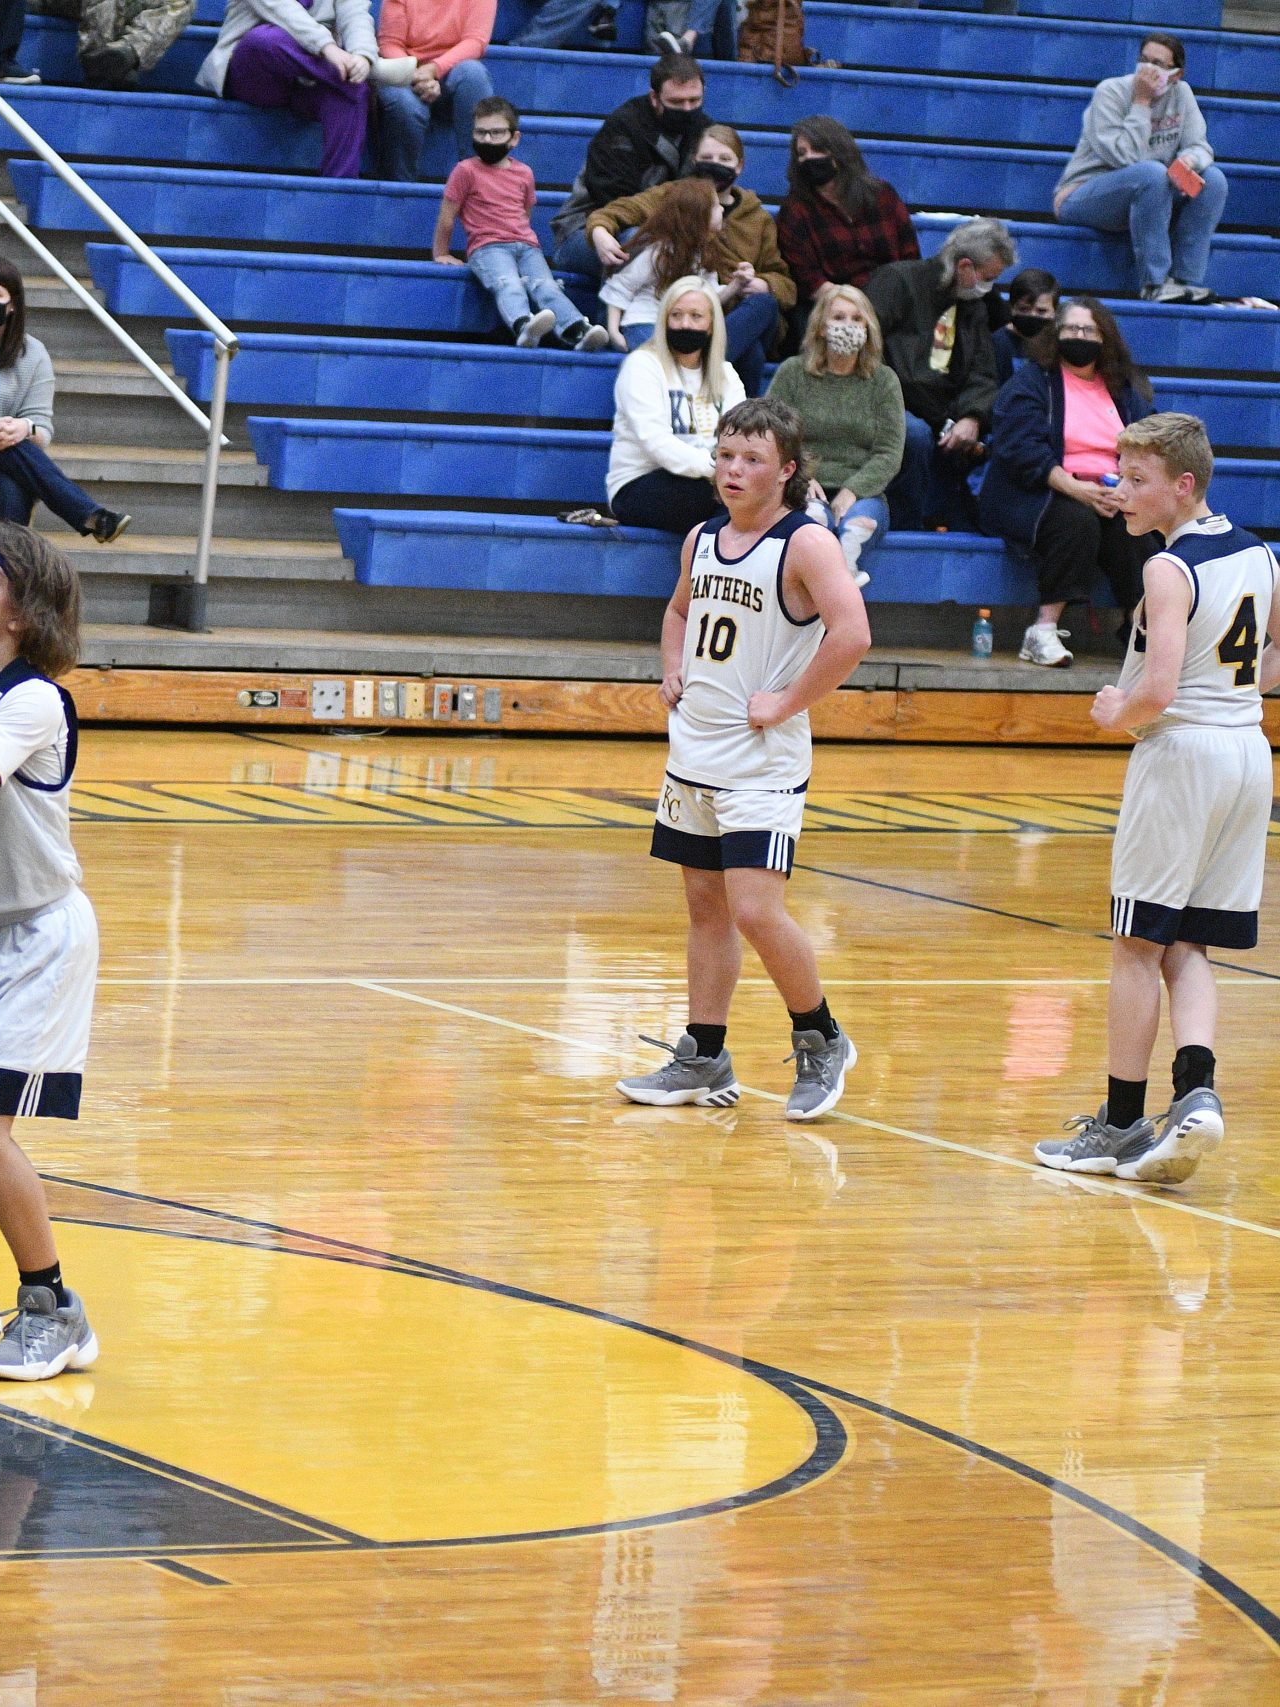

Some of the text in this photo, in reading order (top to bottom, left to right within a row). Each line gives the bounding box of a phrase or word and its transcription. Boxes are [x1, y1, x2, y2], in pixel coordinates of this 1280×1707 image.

[692, 574, 764, 613] ANTHERS
[695, 612, 738, 664] 10
[1215, 592, 1261, 690] 4
[661, 783, 681, 823] KC
